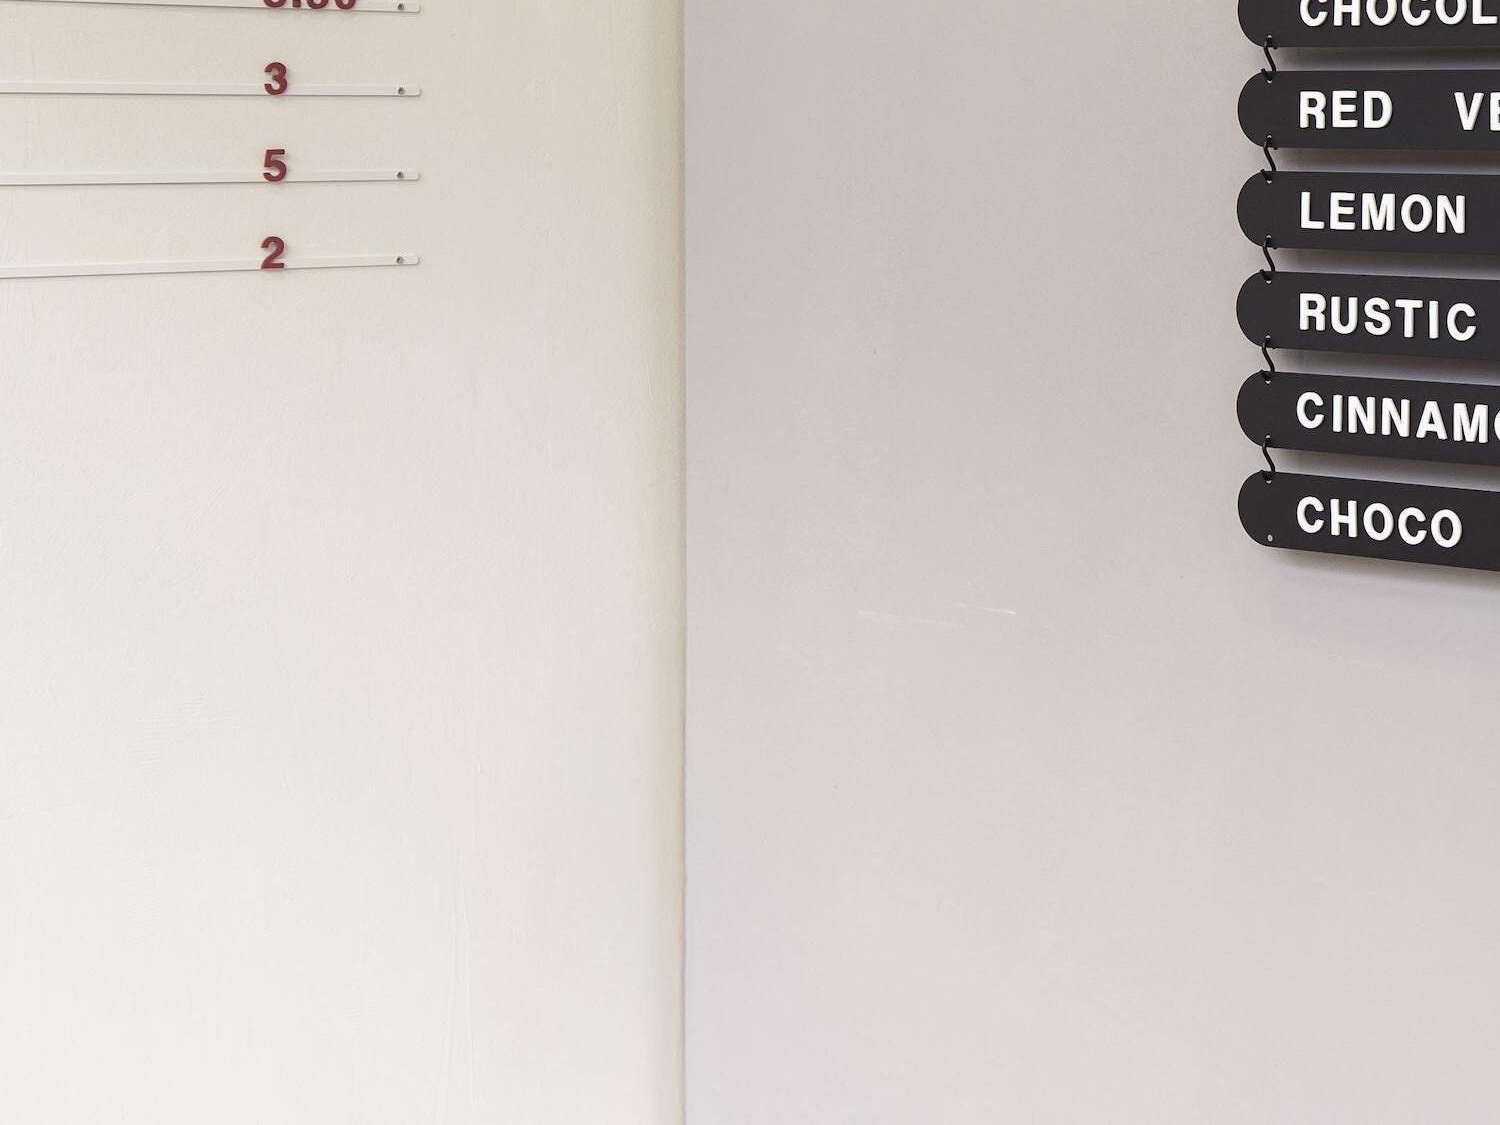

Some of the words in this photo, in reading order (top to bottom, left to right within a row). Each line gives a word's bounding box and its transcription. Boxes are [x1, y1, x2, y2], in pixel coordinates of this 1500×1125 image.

[264, 62, 288, 96] 3
[1299, 90, 1394, 130] RED
[263, 148, 287, 182] 5
[1299, 191, 1467, 234] LEMON
[260, 236, 285, 270] 2
[1298, 293, 1477, 342] RUSTIC
[1296, 495, 1463, 548] CHOCO
